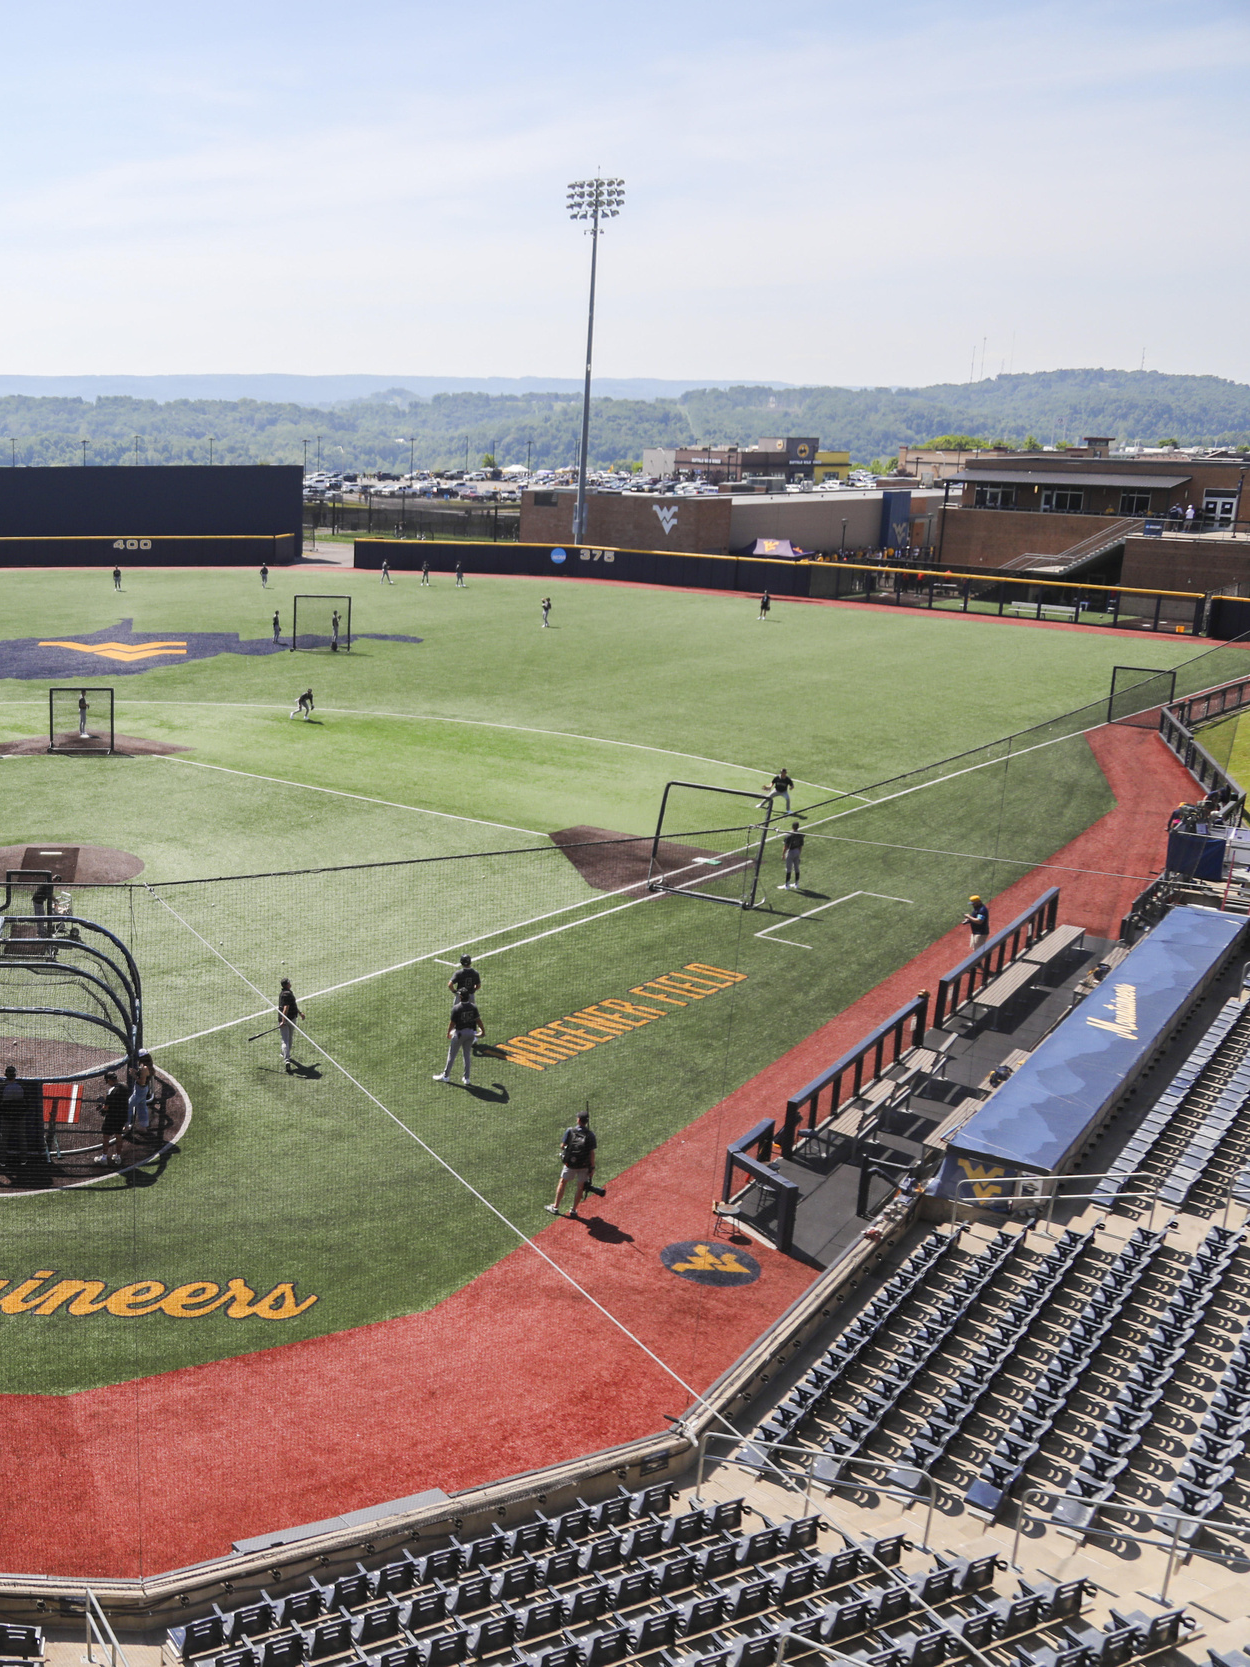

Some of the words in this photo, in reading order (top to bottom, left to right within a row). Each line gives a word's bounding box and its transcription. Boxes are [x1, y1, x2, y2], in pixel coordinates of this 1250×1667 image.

[113, 539, 152, 550] 400
[580, 549, 615, 562] 375
[495, 998, 669, 1071] WAGENER
[627, 962, 748, 1007] FIELD
